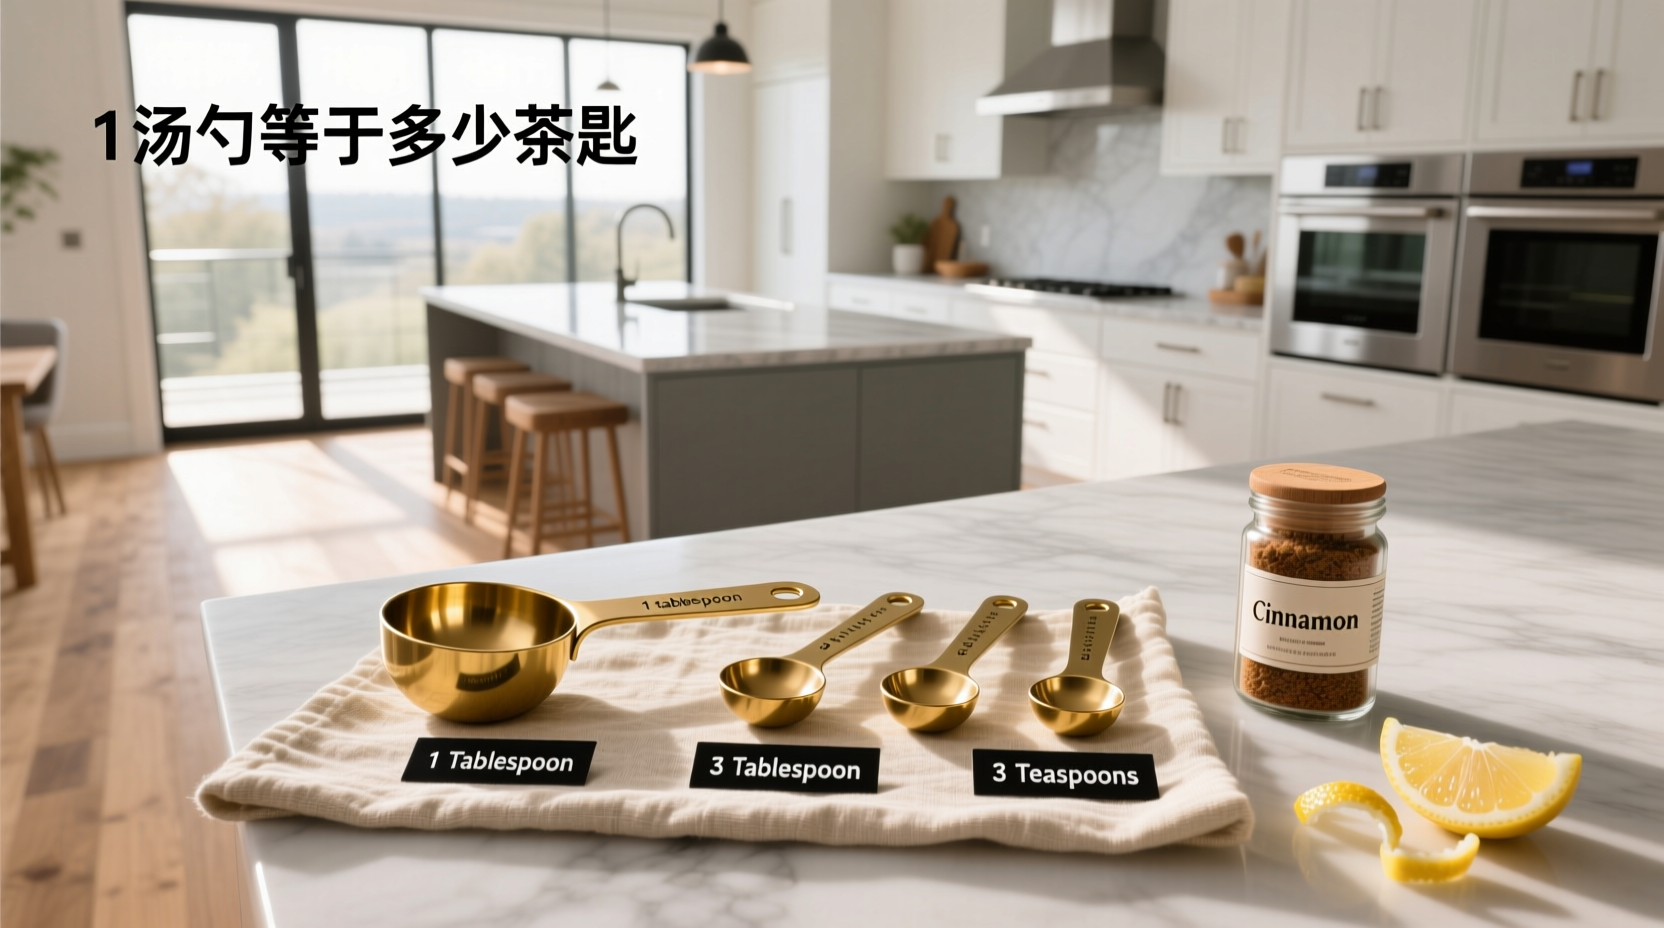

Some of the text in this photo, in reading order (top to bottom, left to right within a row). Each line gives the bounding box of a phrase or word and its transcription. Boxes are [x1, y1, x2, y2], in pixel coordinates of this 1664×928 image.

[1252, 600, 1359, 631] Cinnamon
[429, 751, 574, 776] 1 Tablespoon
[709, 757, 861, 784] 3 Tablespoon
[992, 763, 1139, 789] 3 Teaspoons
